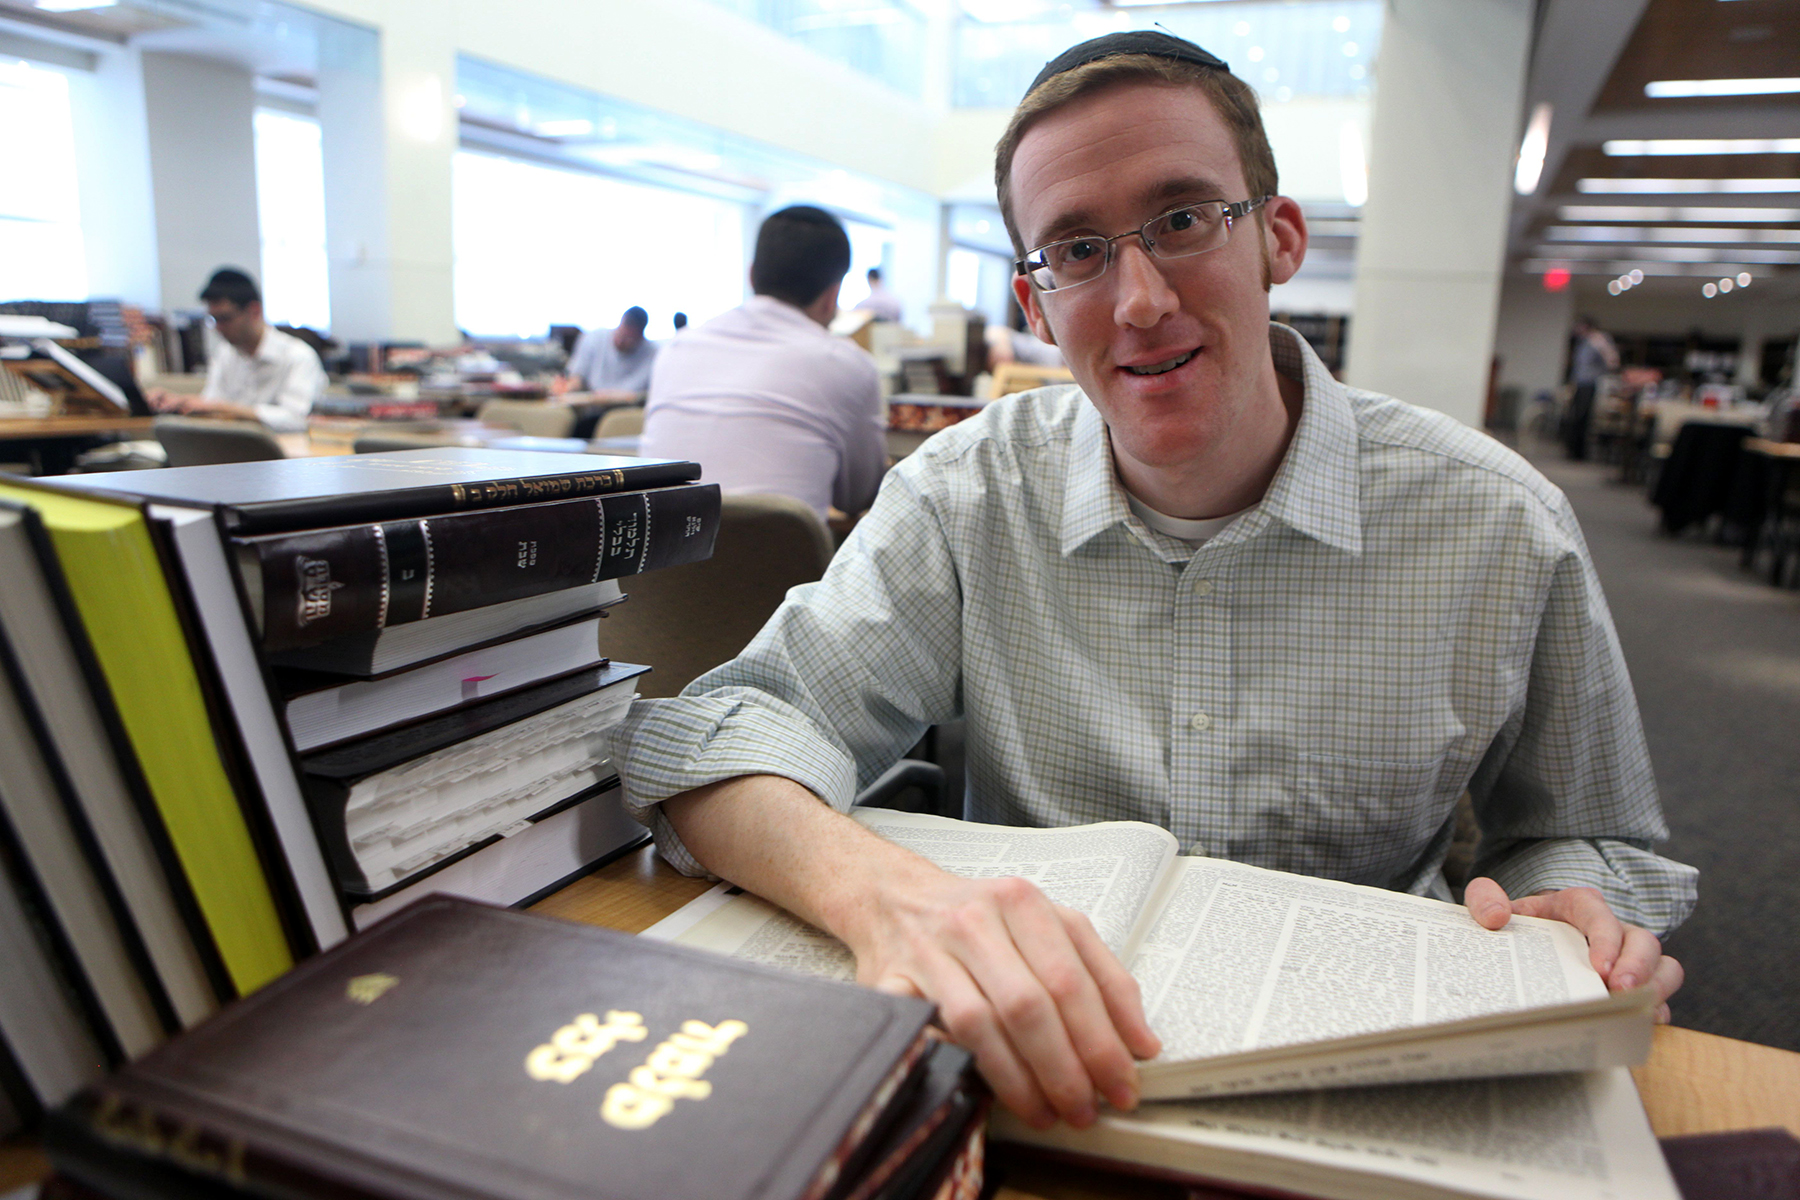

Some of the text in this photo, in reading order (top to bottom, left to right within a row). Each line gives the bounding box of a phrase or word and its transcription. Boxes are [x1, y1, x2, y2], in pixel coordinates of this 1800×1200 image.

[486, 480, 519, 499] חלק
[575, 474, 613, 491] ברכת
[610, 520, 627, 557] בבלי
[624, 512, 641, 560] תלמוד
[517, 541, 528, 569] שבת
[529, 541, 537, 566] מסכת
